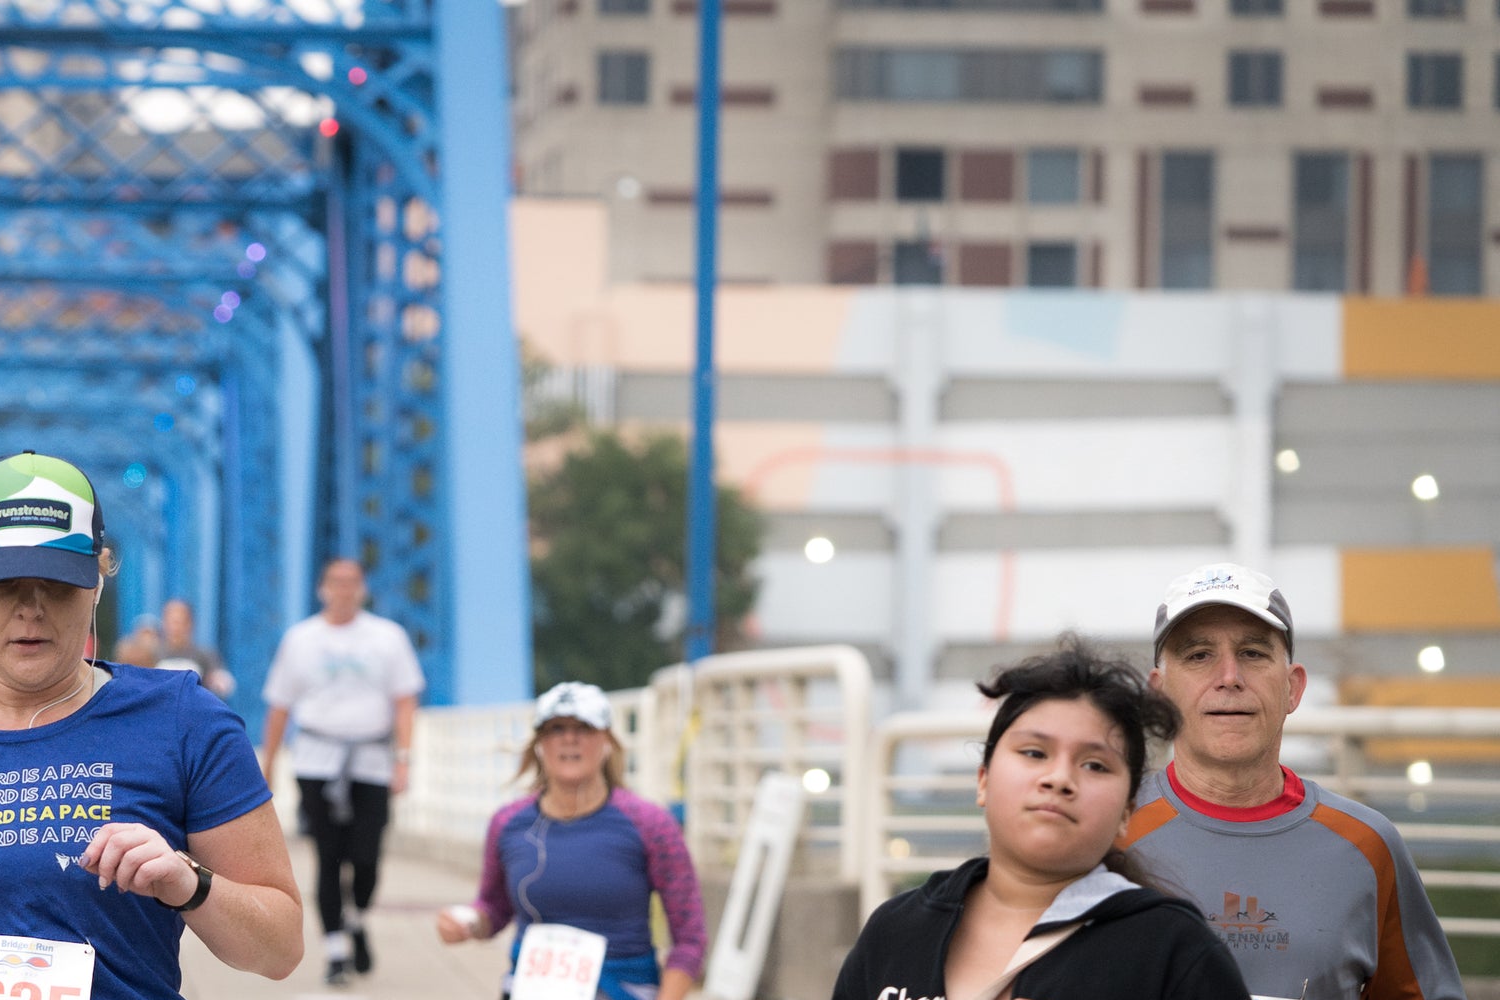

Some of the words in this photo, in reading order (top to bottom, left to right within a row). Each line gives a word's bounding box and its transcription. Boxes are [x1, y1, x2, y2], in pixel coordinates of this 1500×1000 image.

[22, 766, 40, 783] IS
[41, 765, 59, 782] A
[60, 762, 114, 780] PACE
[20, 786, 39, 803] IS
[41, 784, 58, 801] A
[59, 782, 113, 800] PACE
[19, 806, 37, 822] IS
[40, 805, 56, 821] A
[59, 804, 112, 821] PACE
[19, 827, 39, 845] IS
[41, 826, 59, 843] A
[1, 939, 29, 951] Bridge
[35, 942, 54, 953] Run
